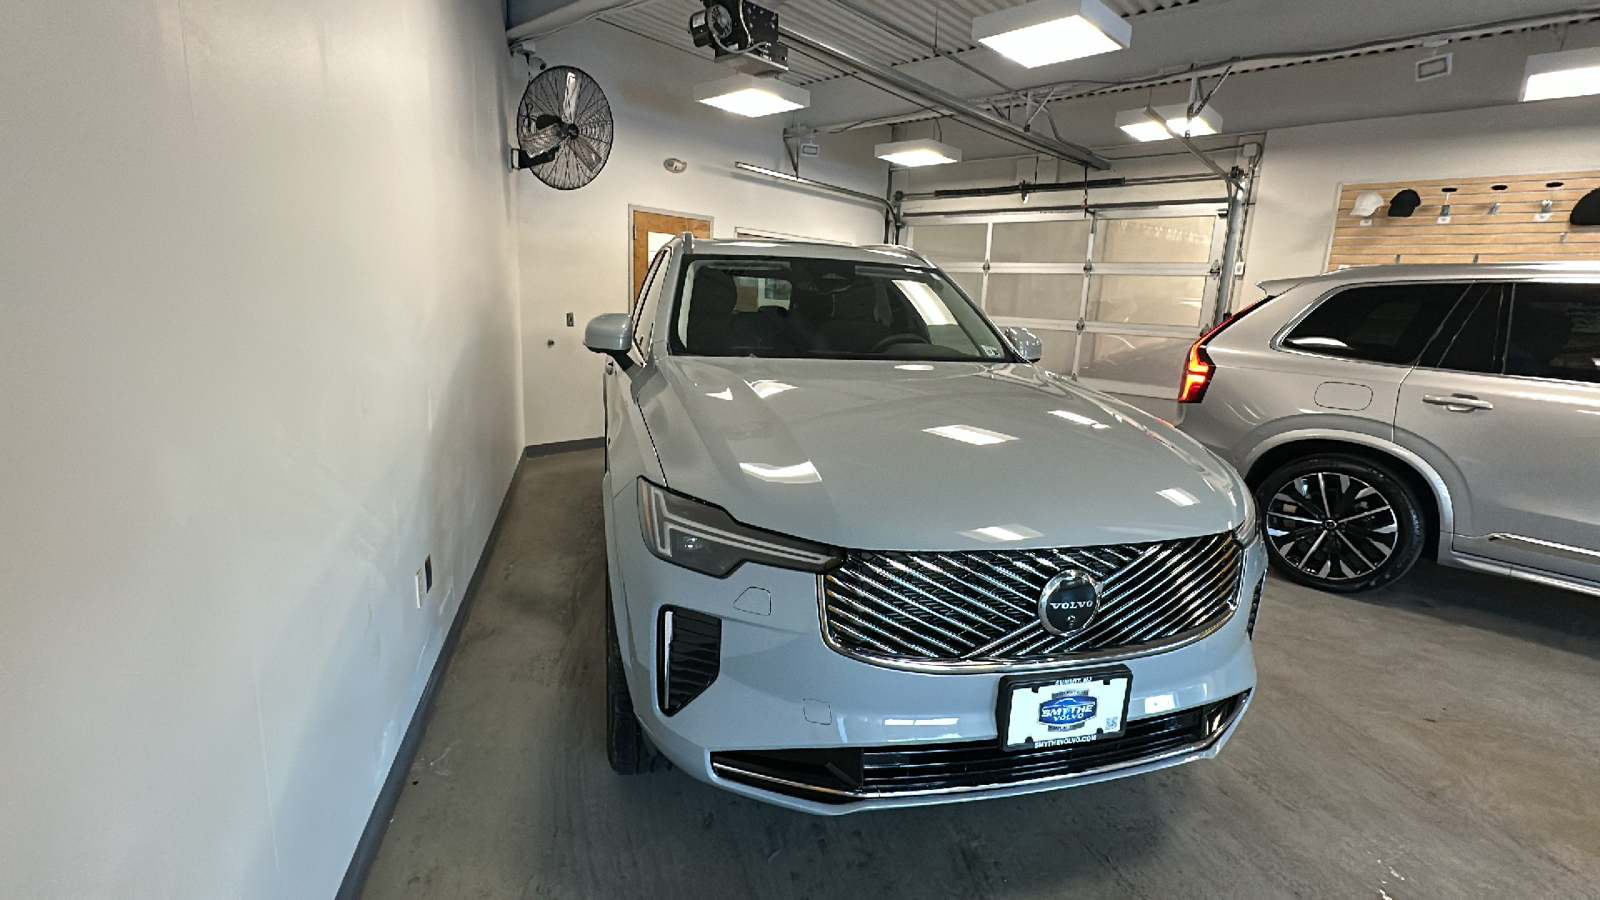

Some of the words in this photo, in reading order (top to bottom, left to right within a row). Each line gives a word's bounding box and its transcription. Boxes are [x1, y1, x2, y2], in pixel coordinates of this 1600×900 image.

[1050, 600, 1093, 609] VOLVO
[1041, 704, 1094, 717] SMYTHE
[1053, 713, 1084, 722] VOLVO
[1034, 735, 1097, 749] SMYTHEVOLVO.COM
